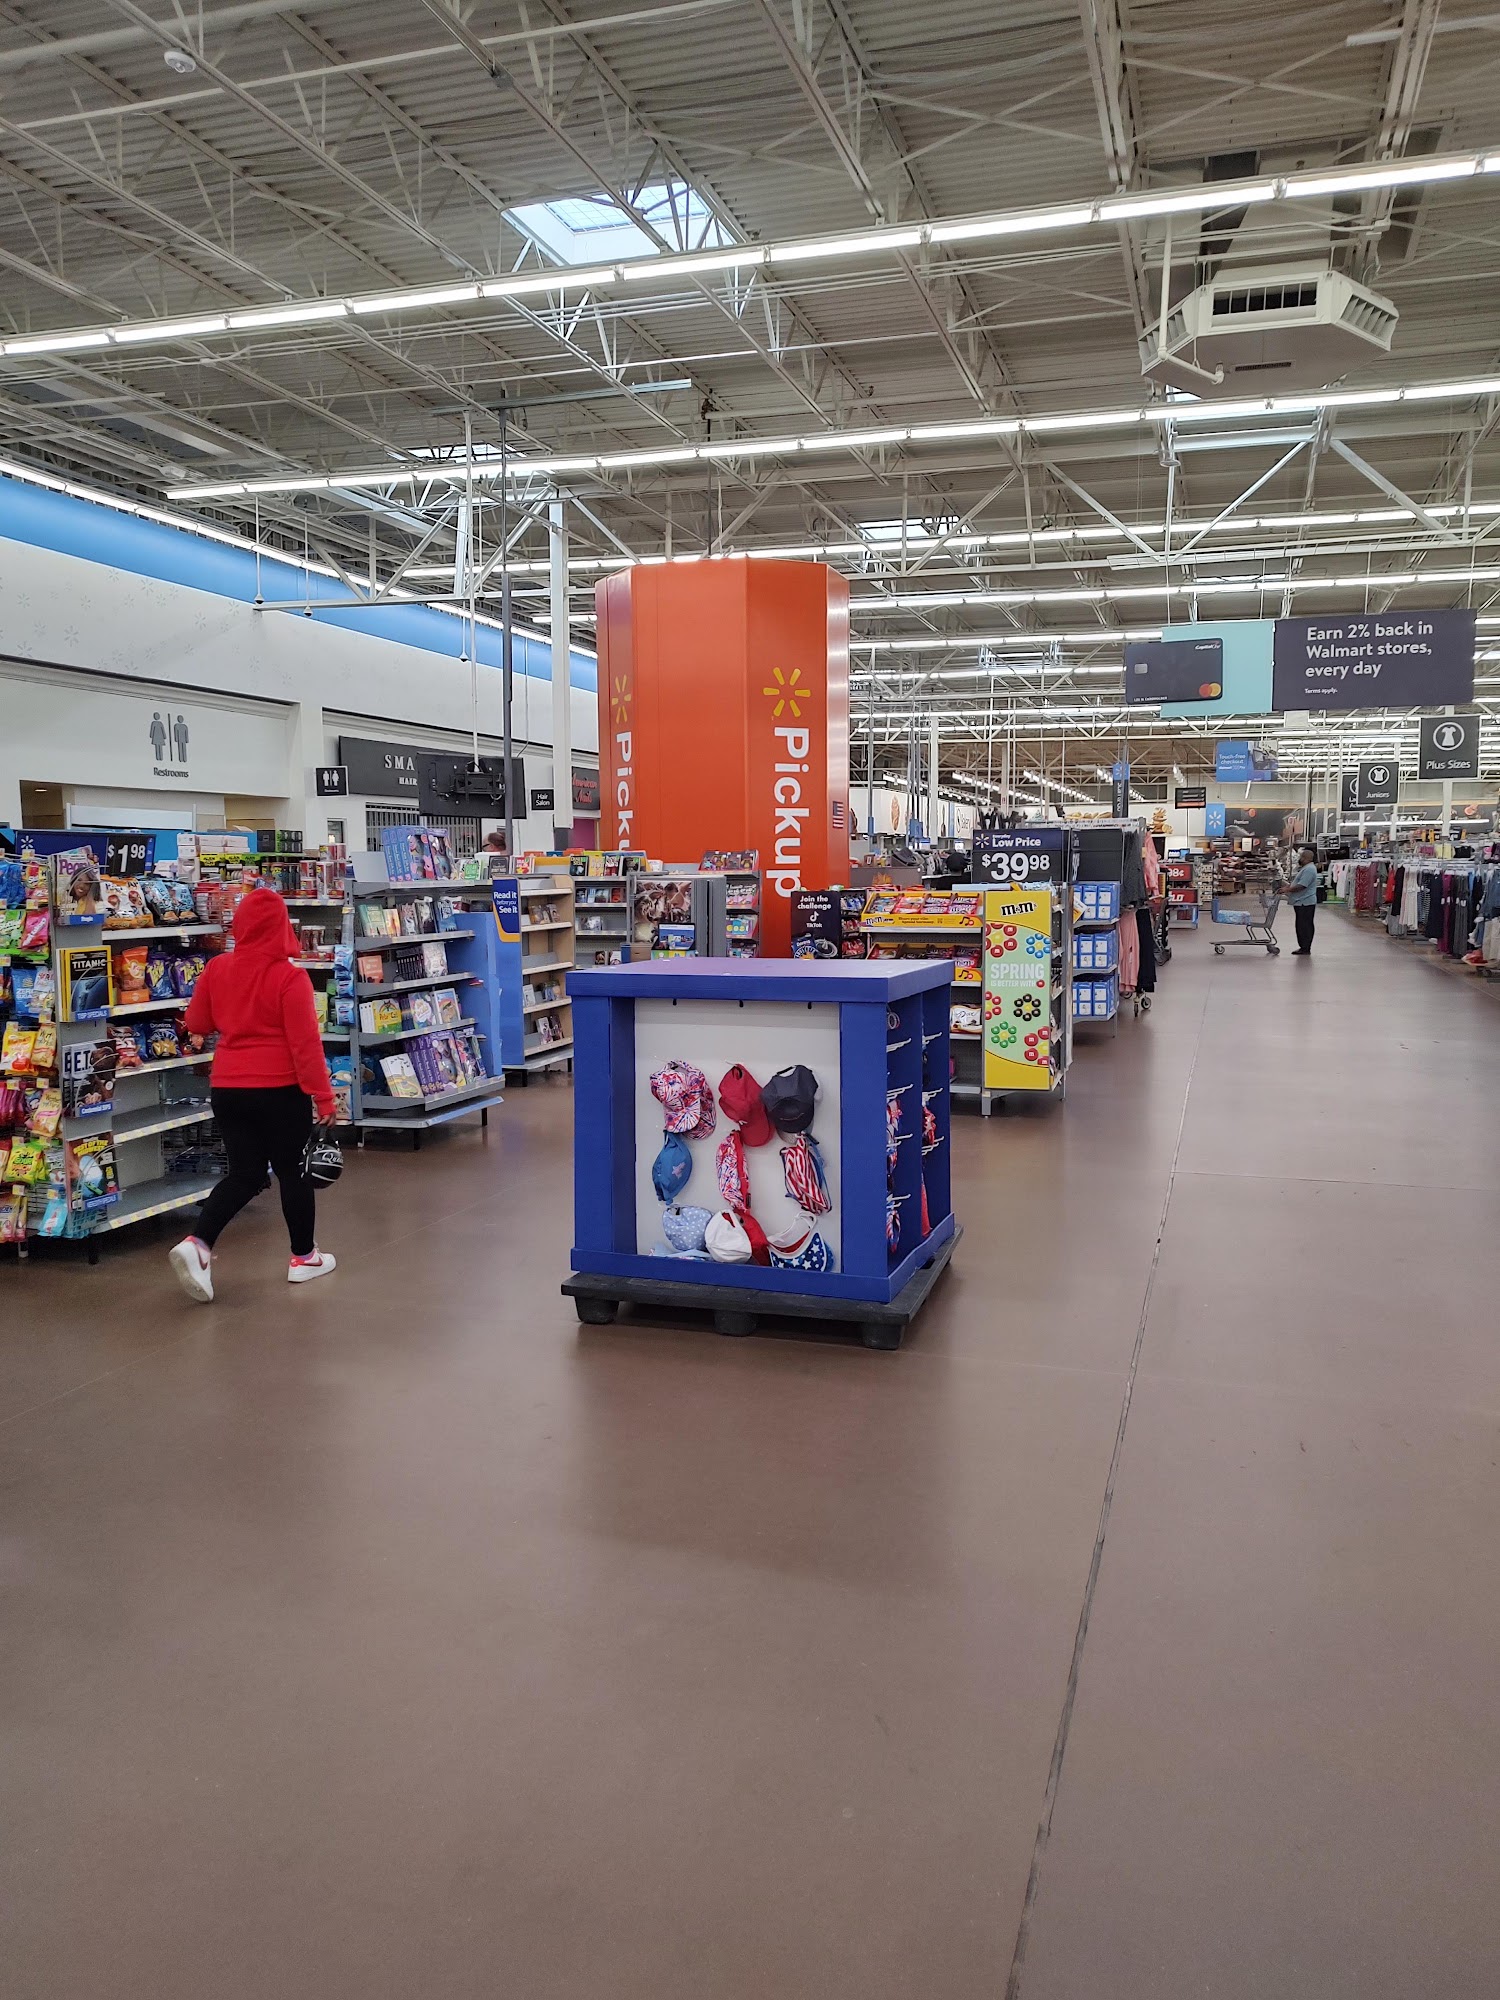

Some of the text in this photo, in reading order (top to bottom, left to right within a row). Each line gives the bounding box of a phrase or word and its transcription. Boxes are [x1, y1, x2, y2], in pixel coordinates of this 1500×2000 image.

[1307, 620, 1434, 641] Earn 2% back in
[1306, 642, 1432, 659] Walmart stores,
[1305, 660, 1383, 680] every day
[1425, 759, 1472, 770] Plus Sizes
[153, 766, 189, 778] Restrooms
[398, 777, 418, 786] HAIR
[572, 773, 598, 788] American
[574, 789, 593, 803] Nails
[1366, 791, 1390, 799] Juniors
[766, 727, 810, 898] Pickup
[992, 837, 1042, 848] Low Price
[493, 891, 511, 899] Read
[499, 906, 511, 914] See
[72, 959, 107, 969] TITANIC
[990, 963, 1045, 979] SPRING
